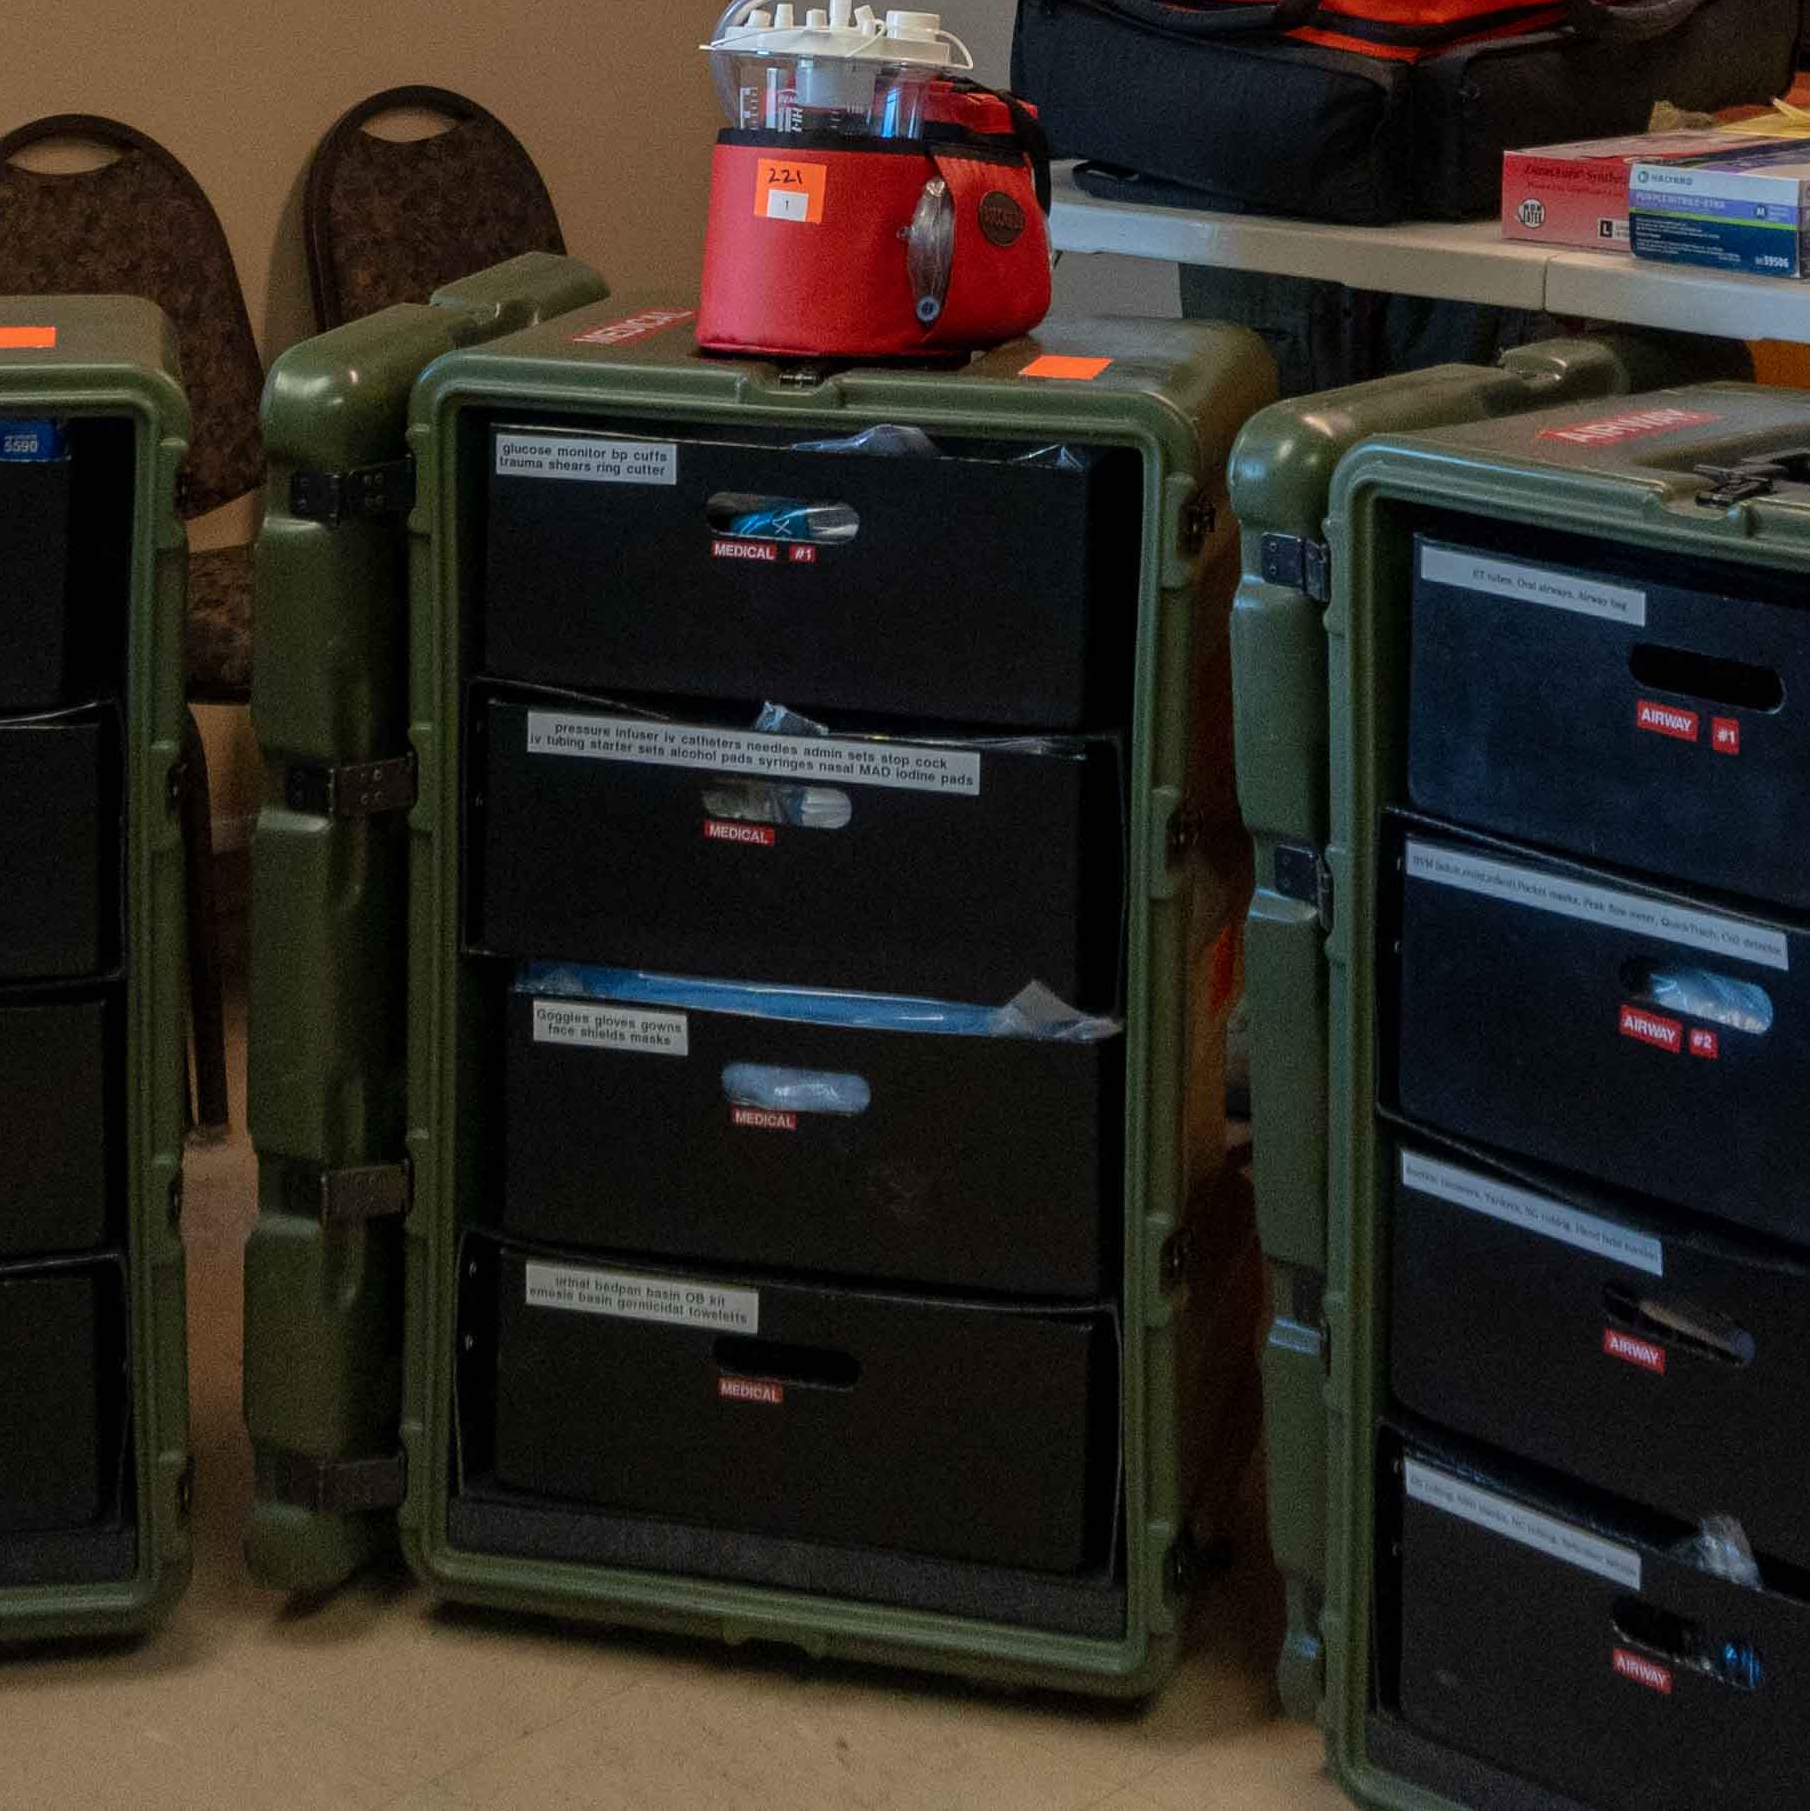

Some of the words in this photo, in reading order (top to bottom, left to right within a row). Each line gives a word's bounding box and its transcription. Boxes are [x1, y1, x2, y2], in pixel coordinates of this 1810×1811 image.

[768, 168, 803, 185] 221
[502, 444, 553, 457] glucose
[557, 446, 607, 459] monitor
[611, 449, 629, 463] bp
[633, 451, 668, 463] cuffs
[499, 456, 544, 469] trauma
[548, 459, 592, 471] shears
[596, 462, 622, 476] ring
[626, 464, 666, 476] cutter
[714, 542, 776, 561] MEDICAL
[1640, 706, 1693, 735] AIRWAY
[1717, 728, 1737, 745] #1
[555, 723, 611, 739] pressure
[615, 727, 659, 741] infuser
[664, 731, 676, 743] iv
[680, 733, 742, 751] catheters
[746, 741, 798, 756] needles
[803, 745, 843, 760] admin
[847, 750, 876, 763] sets
[880, 754, 910, 769] stop
[915, 756, 948, 771] cock
[530, 735, 542, 746] iv
[546, 736, 586, 752] tubing
[590, 740, 633, 753] starter
[637, 745, 665, 757] sets
[670, 747, 718, 762] alcohol
[721, 751, 753, 765] pads
[758, 755, 814, 773] syringes
[818, 761, 855, 774] nasal
[859, 764, 891, 778] MAD
[895, 769, 936, 783] iodine
[940, 773, 974, 788] pads
[708, 824, 770, 844] MEDICAL
[536, 1008, 589, 1024] Goggles
[594, 1014, 636, 1029] gloves
[640, 1019, 682, 1033] gowns
[1622, 1012, 1678, 1044] AIRWAY
[1692, 1031, 1713, 1049] #2
[548, 1023, 576, 1036] face
[580, 1027, 626, 1041] shields
[629, 1032, 672, 1046] masks
[735, 1110, 795, 1128] MEDICAL
[555, 1276, 590, 1289] urinal
[594, 1279, 641, 1297] bedpan
[646, 1284, 681, 1300] basin
[685, 1291, 704, 1304] OB
[709, 1295, 726, 1307] kit
[577, 1291, 612, 1307] basin
[1609, 1335, 1662, 1367] AIRWAY
[720, 1381, 781, 1403] MEDICAL
[1616, 1654, 1668, 1687] AIRWAY
